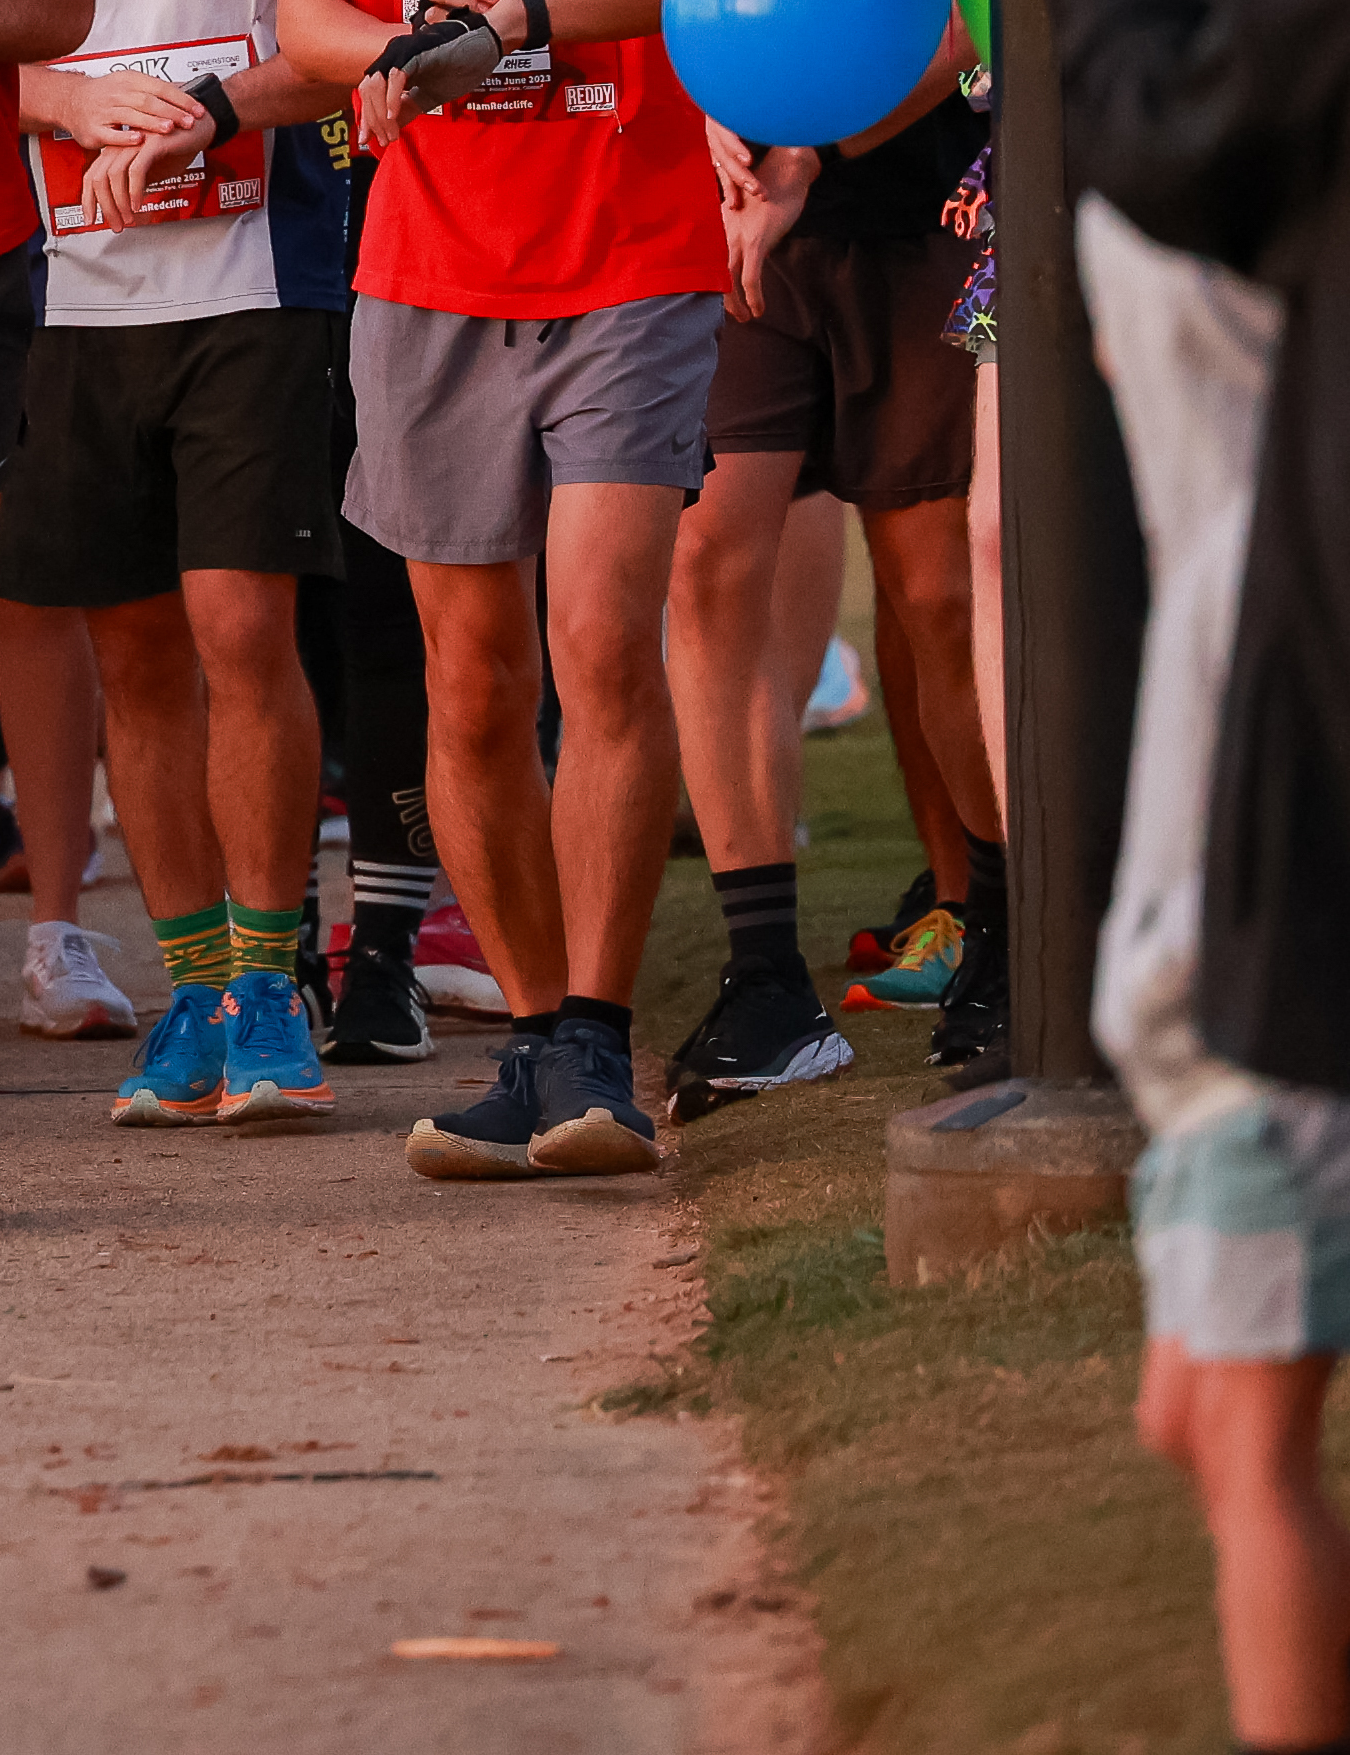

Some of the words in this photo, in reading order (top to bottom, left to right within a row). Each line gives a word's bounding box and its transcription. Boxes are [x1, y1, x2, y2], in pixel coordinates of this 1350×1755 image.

[503, 58, 532, 70] RHEE
[504, 76, 527, 86] June
[528, 74, 552, 84] 2023
[567, 85, 612, 106] REDDY
[466, 99, 534, 111] #IamRedcliffe
[219, 179, 259, 202] REDDY
[139, 198, 190, 213] Redcliffe
